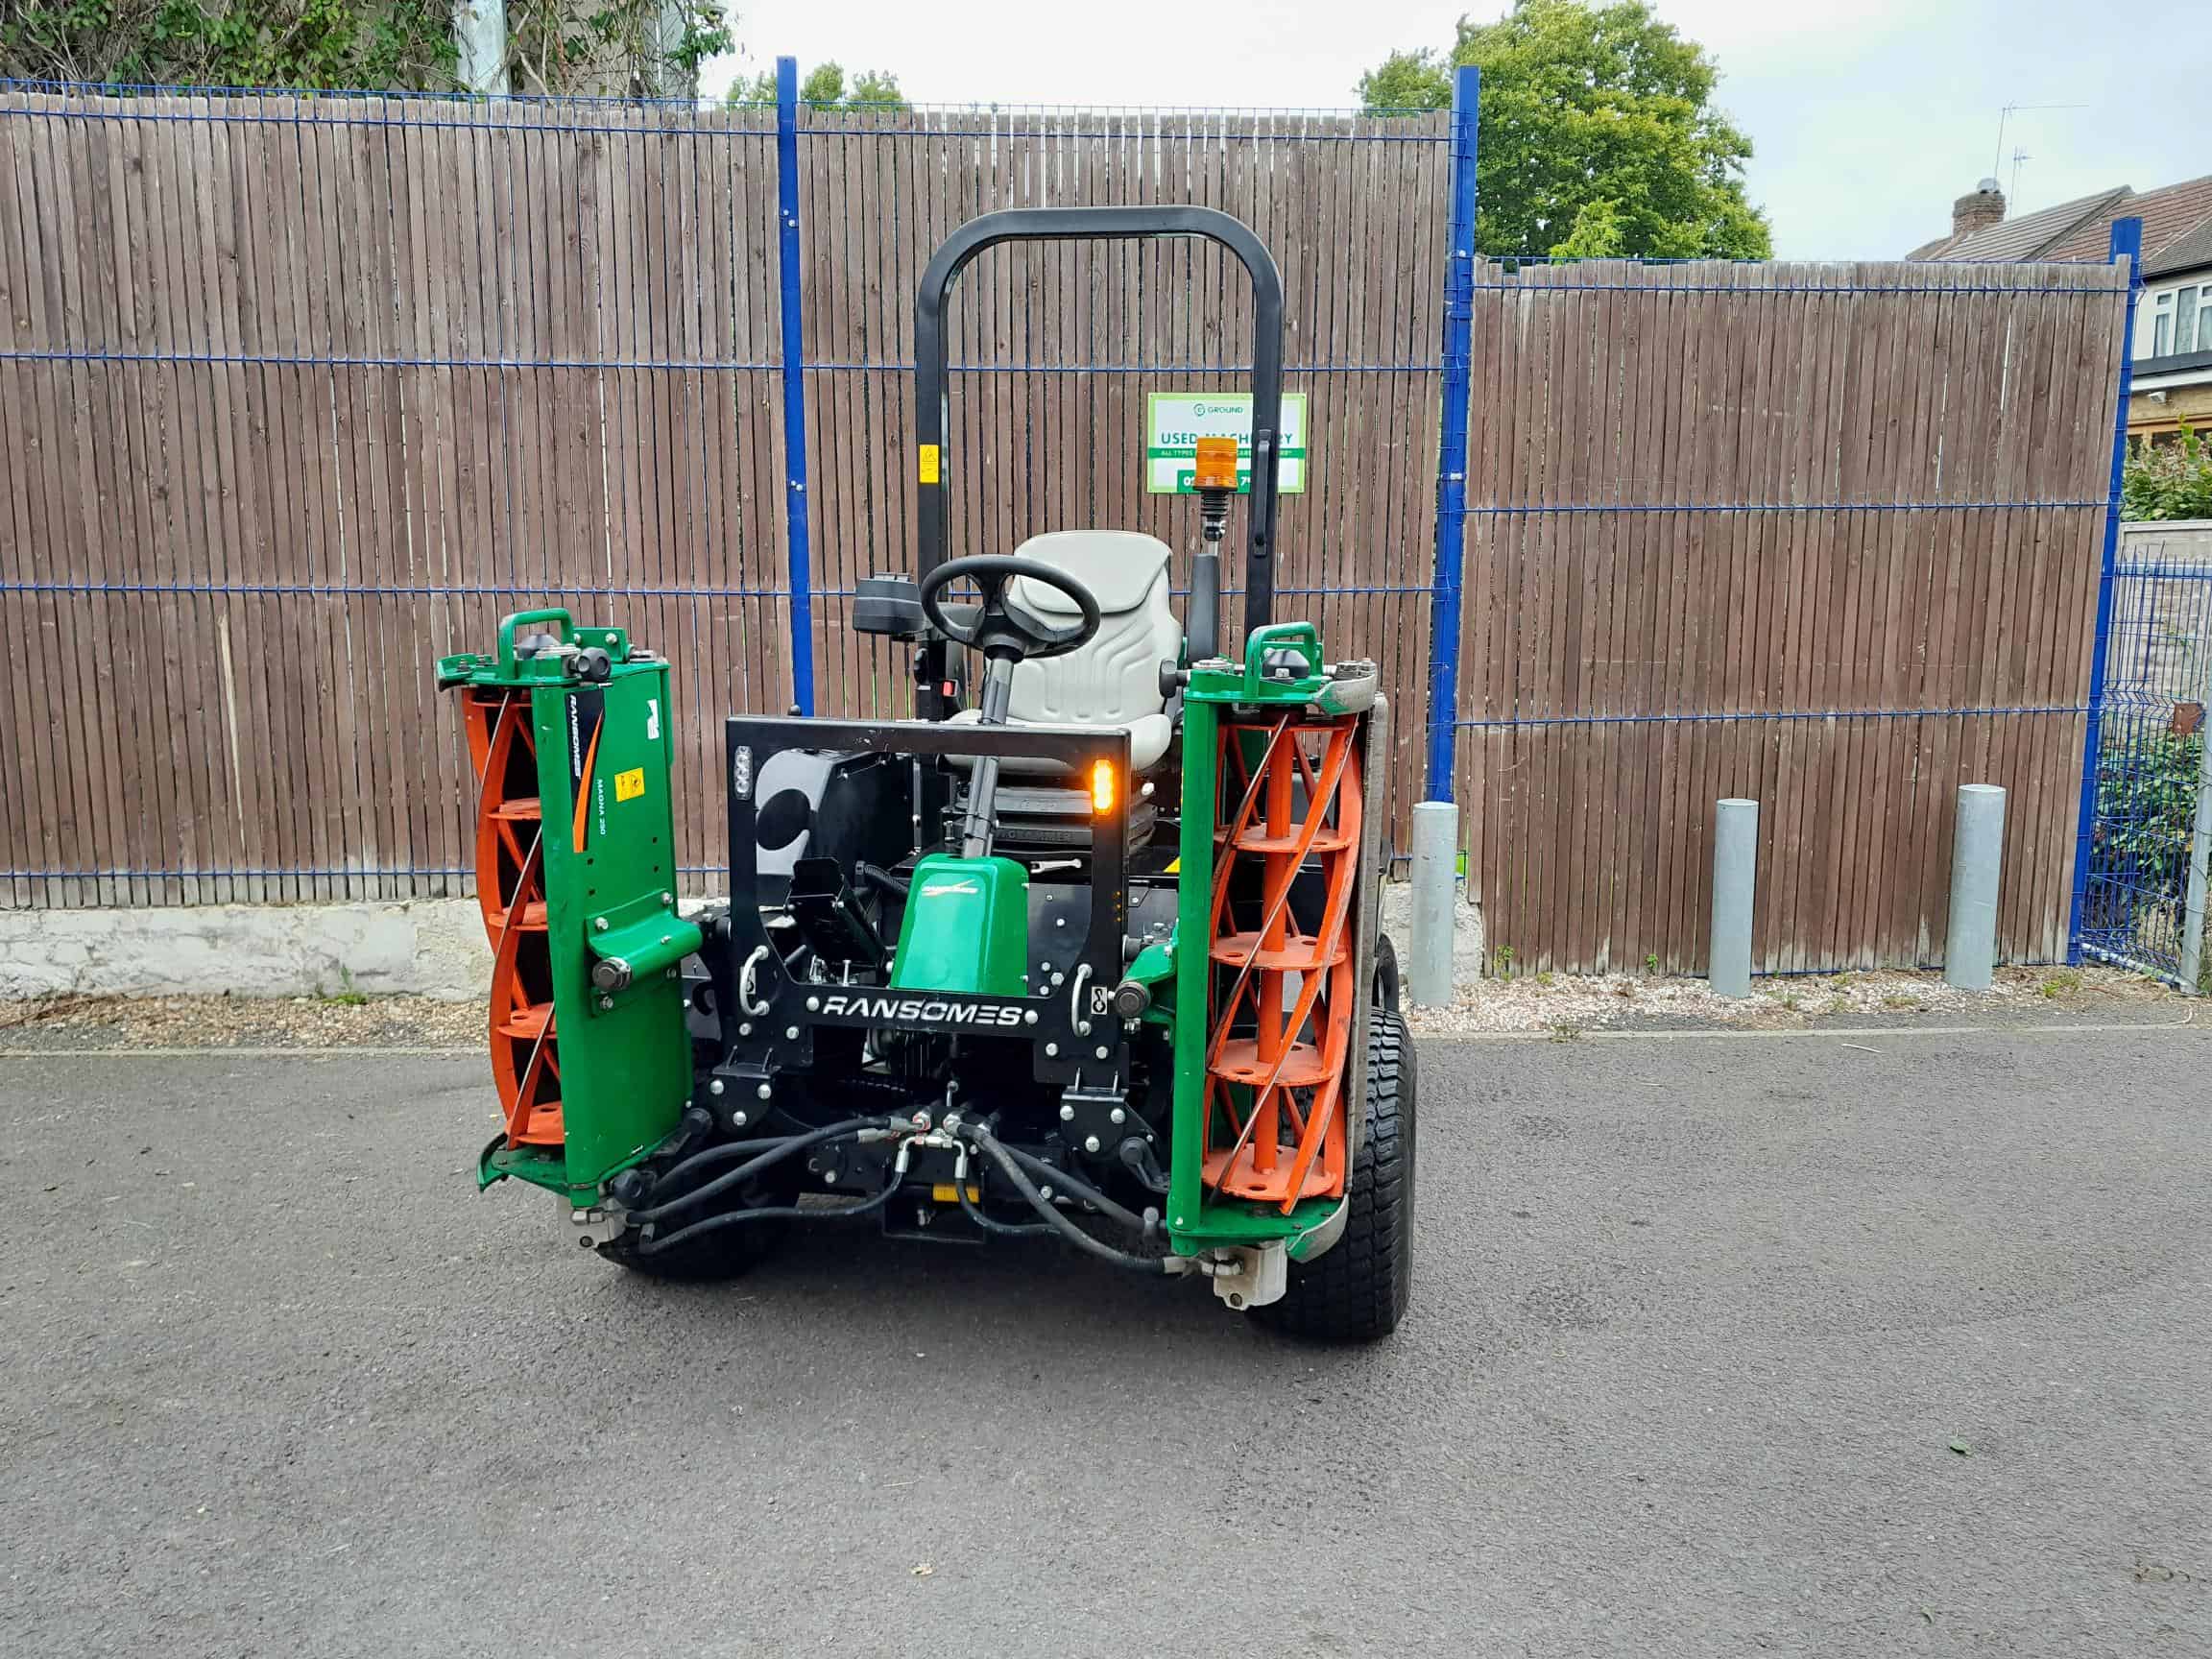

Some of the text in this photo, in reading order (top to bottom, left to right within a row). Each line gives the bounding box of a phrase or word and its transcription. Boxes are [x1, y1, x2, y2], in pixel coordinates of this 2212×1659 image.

[1207, 406, 1244, 415] GROUND
[1161, 433, 1198, 445] USED
[570, 694, 582, 779] RANSOMES
[823, 996, 1022, 1026] RANSOMES
